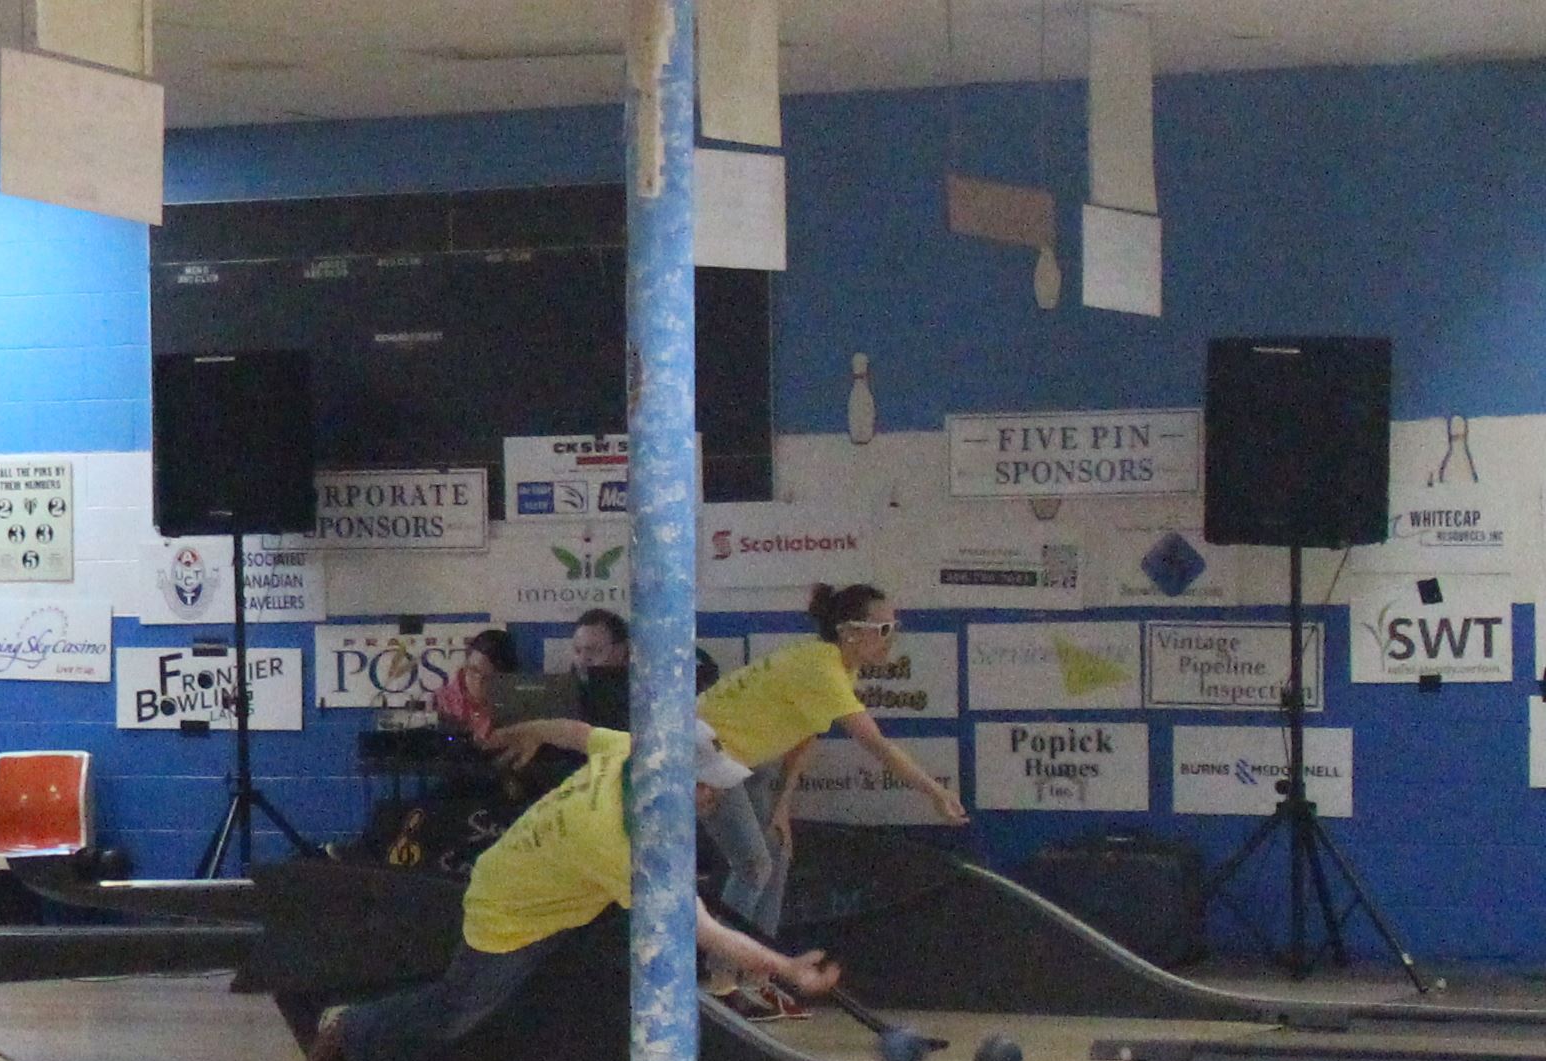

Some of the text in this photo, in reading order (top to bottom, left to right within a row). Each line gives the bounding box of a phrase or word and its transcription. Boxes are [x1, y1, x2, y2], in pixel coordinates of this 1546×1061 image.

[997, 424, 1151, 451] FIVE PIN
[995, 457, 1154, 485] SPONSORS
[324, 483, 469, 508] RPORATE
[317, 515, 445, 540] PONSORS
[1410, 510, 1481, 528] WHITECAP
[739, 533, 859, 554] Scotiabank
[244, 573, 303, 589] ANADIAN
[518, 584, 626, 603] innovati
[1157, 629, 1241, 654] Vintage
[1388, 617, 1503, 660] SWT
[159, 653, 284, 695] FRONIER
[1178, 655, 1267, 681] Pipeline
[1199, 681, 1313, 704] Inspectin
[1010, 726, 1115, 759] Popick
[1025, 758, 1100, 779] Homes
[1180, 763, 1230, 776] BURNS
